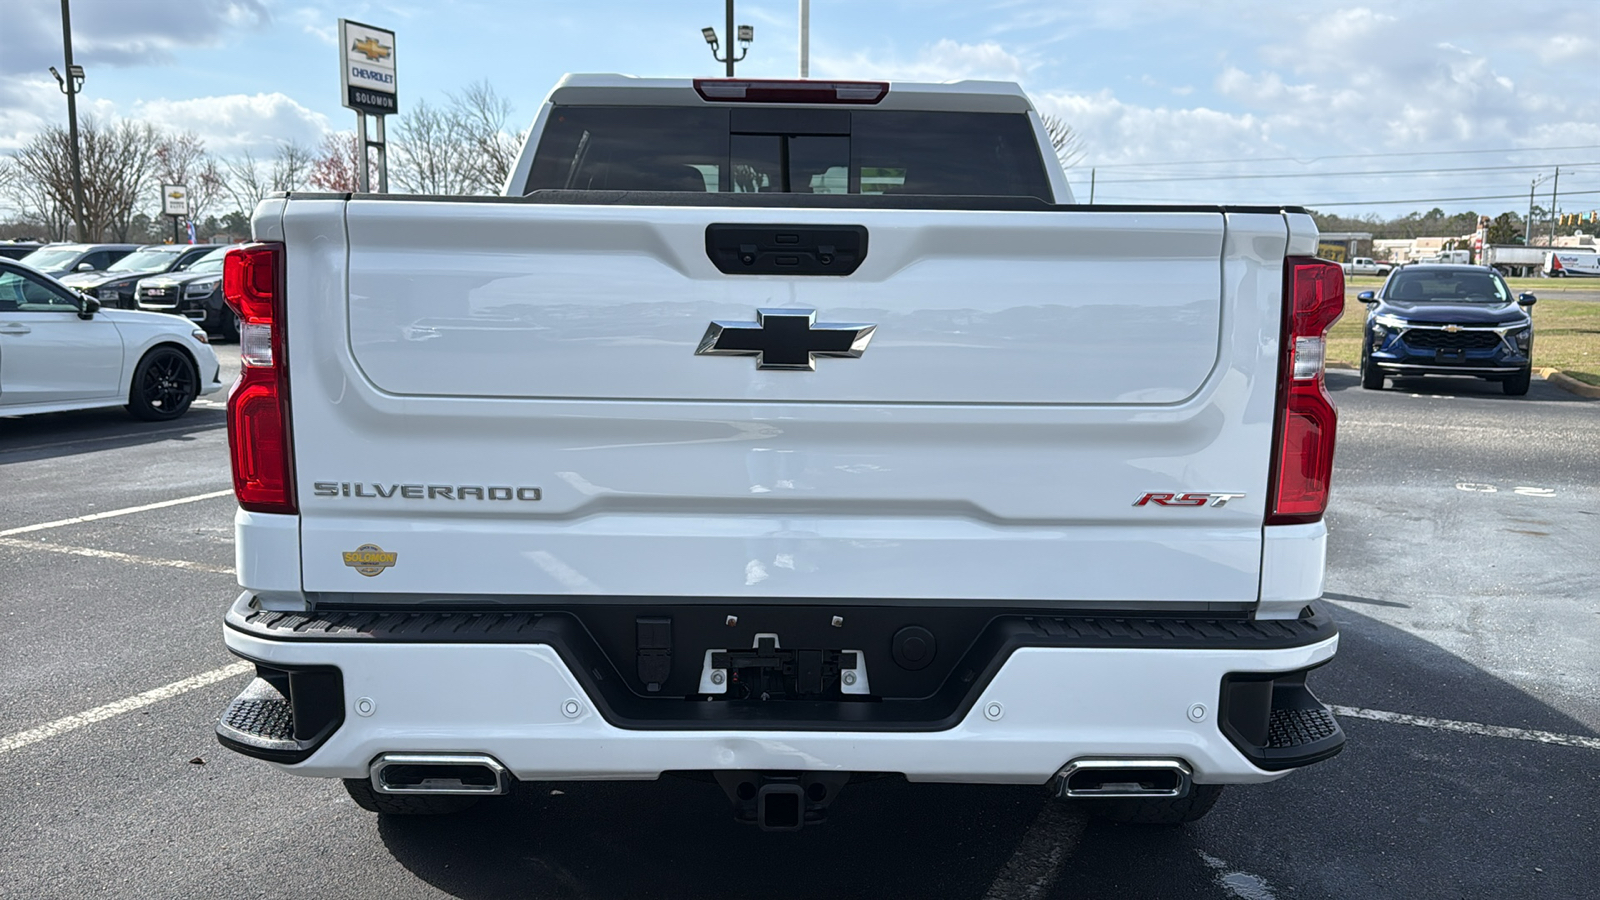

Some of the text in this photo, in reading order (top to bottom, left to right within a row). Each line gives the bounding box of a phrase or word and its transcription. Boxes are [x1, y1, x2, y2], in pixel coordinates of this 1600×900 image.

[352, 66, 393, 84] CHEVROLET
[355, 92, 393, 108] SOLOMON
[313, 481, 542, 501] SILVERADO
[1132, 491, 1246, 507] RST
[345, 552, 393, 562] SOLOMON
